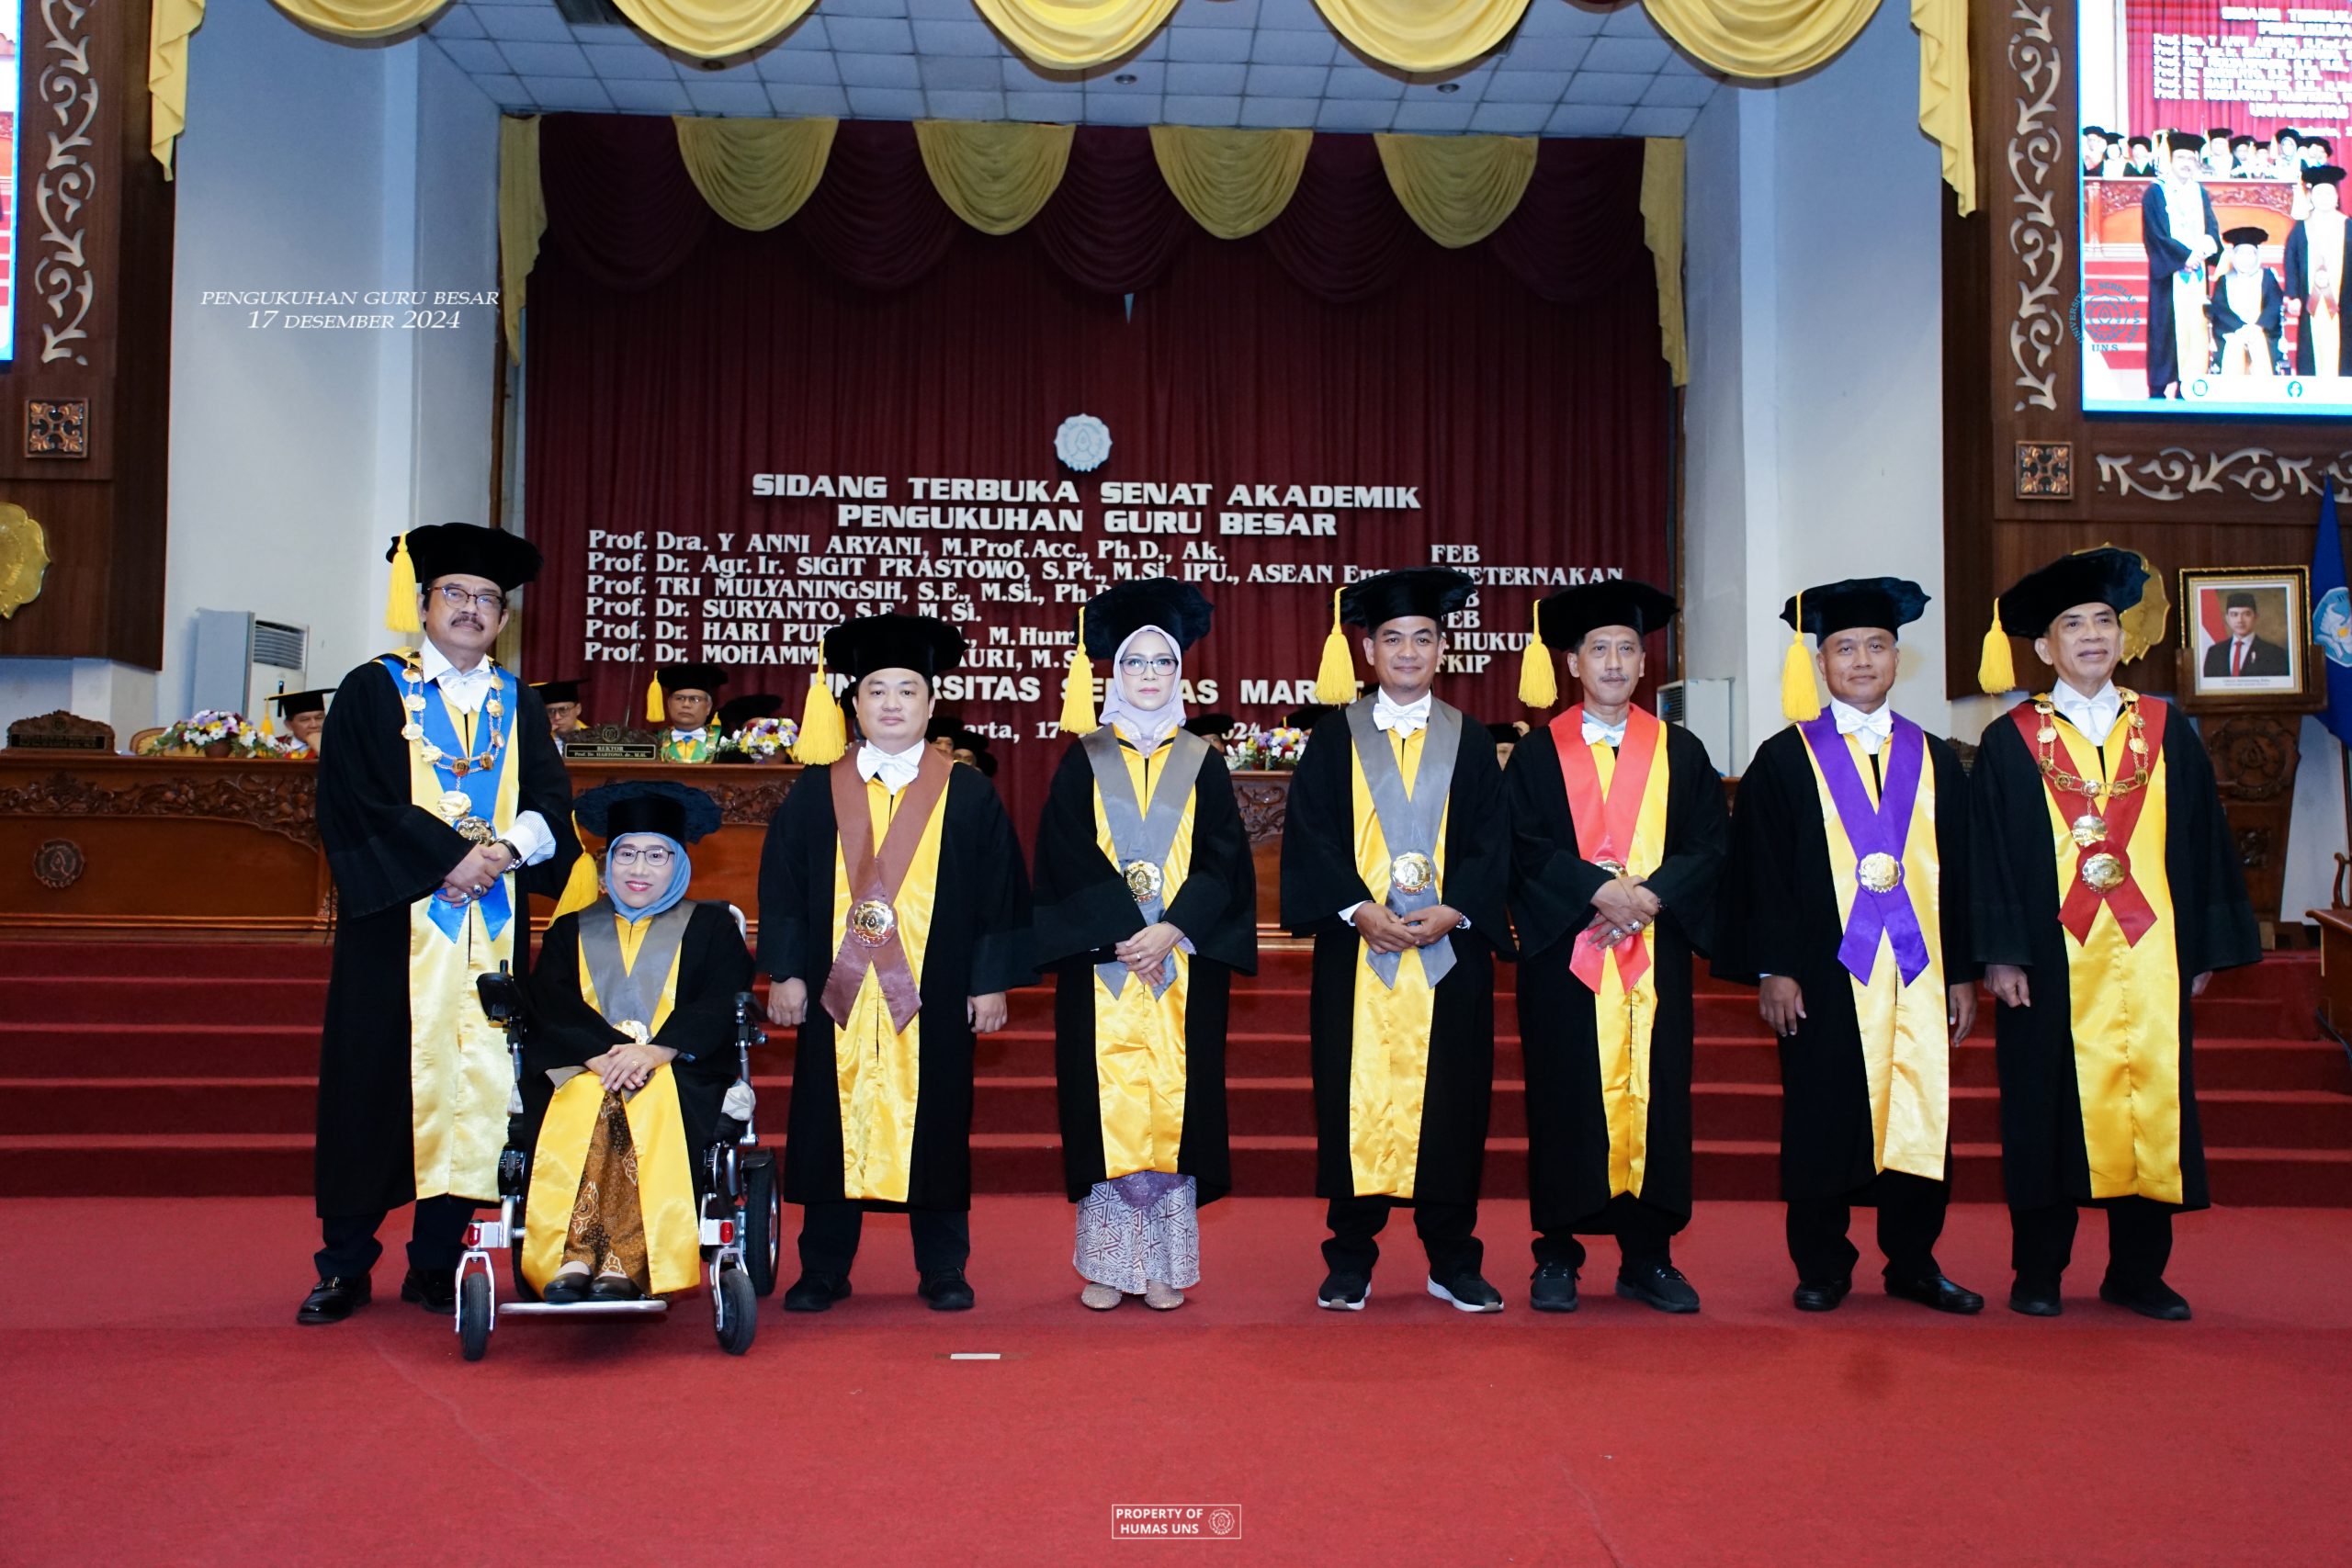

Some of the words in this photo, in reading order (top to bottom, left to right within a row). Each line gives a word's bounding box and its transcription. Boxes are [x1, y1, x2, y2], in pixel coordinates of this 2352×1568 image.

[752, 473, 888, 499] SIDANG
[908, 477, 1080, 503] TERBUKA
[1101, 481, 1213, 505] SENAT
[1227, 484, 1421, 509] AKADEMIK
[838, 504, 1083, 532] PENGUKUHAN
[1104, 511, 1202, 534] GURU
[1219, 513, 1338, 536] BESAR
[589, 530, 648, 550] Prof.
[656, 531, 708, 551] Dra.
[718, 533, 735, 552] Y
[746, 534, 810, 554] ANNI
[826, 536, 930, 558] ARYANI,
[1097, 540, 1172, 560] Ph.D.,
[1182, 541, 1225, 561] Ak.
[1430, 545, 1480, 563] FEB
[588, 552, 647, 572] Prof.
[656, 553, 689, 573] Dr.
[797, 557, 866, 577] SIGIT
[879, 558, 1031, 582] PRASTOWO,
[1042, 561, 1106, 584] S.Pt.,
[1184, 563, 1239, 585] IPU.,
[1248, 564, 1333, 584] ASEAN
[587, 575, 647, 595] Prof.
[655, 577, 701, 596] TRI
[715, 579, 909, 603] MULYANINGSIH,
[918, 581, 970, 603] S.E.,
[981, 582, 1045, 605] M.Si.,
[586, 597, 646, 616] Prof.
[655, 598, 689, 617] Dr.
[702, 599, 845, 624] SURYANTO,
[1442, 610, 1480, 628] EB
[585, 619, 646, 639] Prof.
[655, 620, 689, 640] Dr.
[702, 622, 770, 641] HARI
[584, 641, 644, 662] Prof.
[655, 643, 688, 663] Dr.
[702, 645, 827, 665] MOHAMM
[1035, 721, 1060, 739] 17
